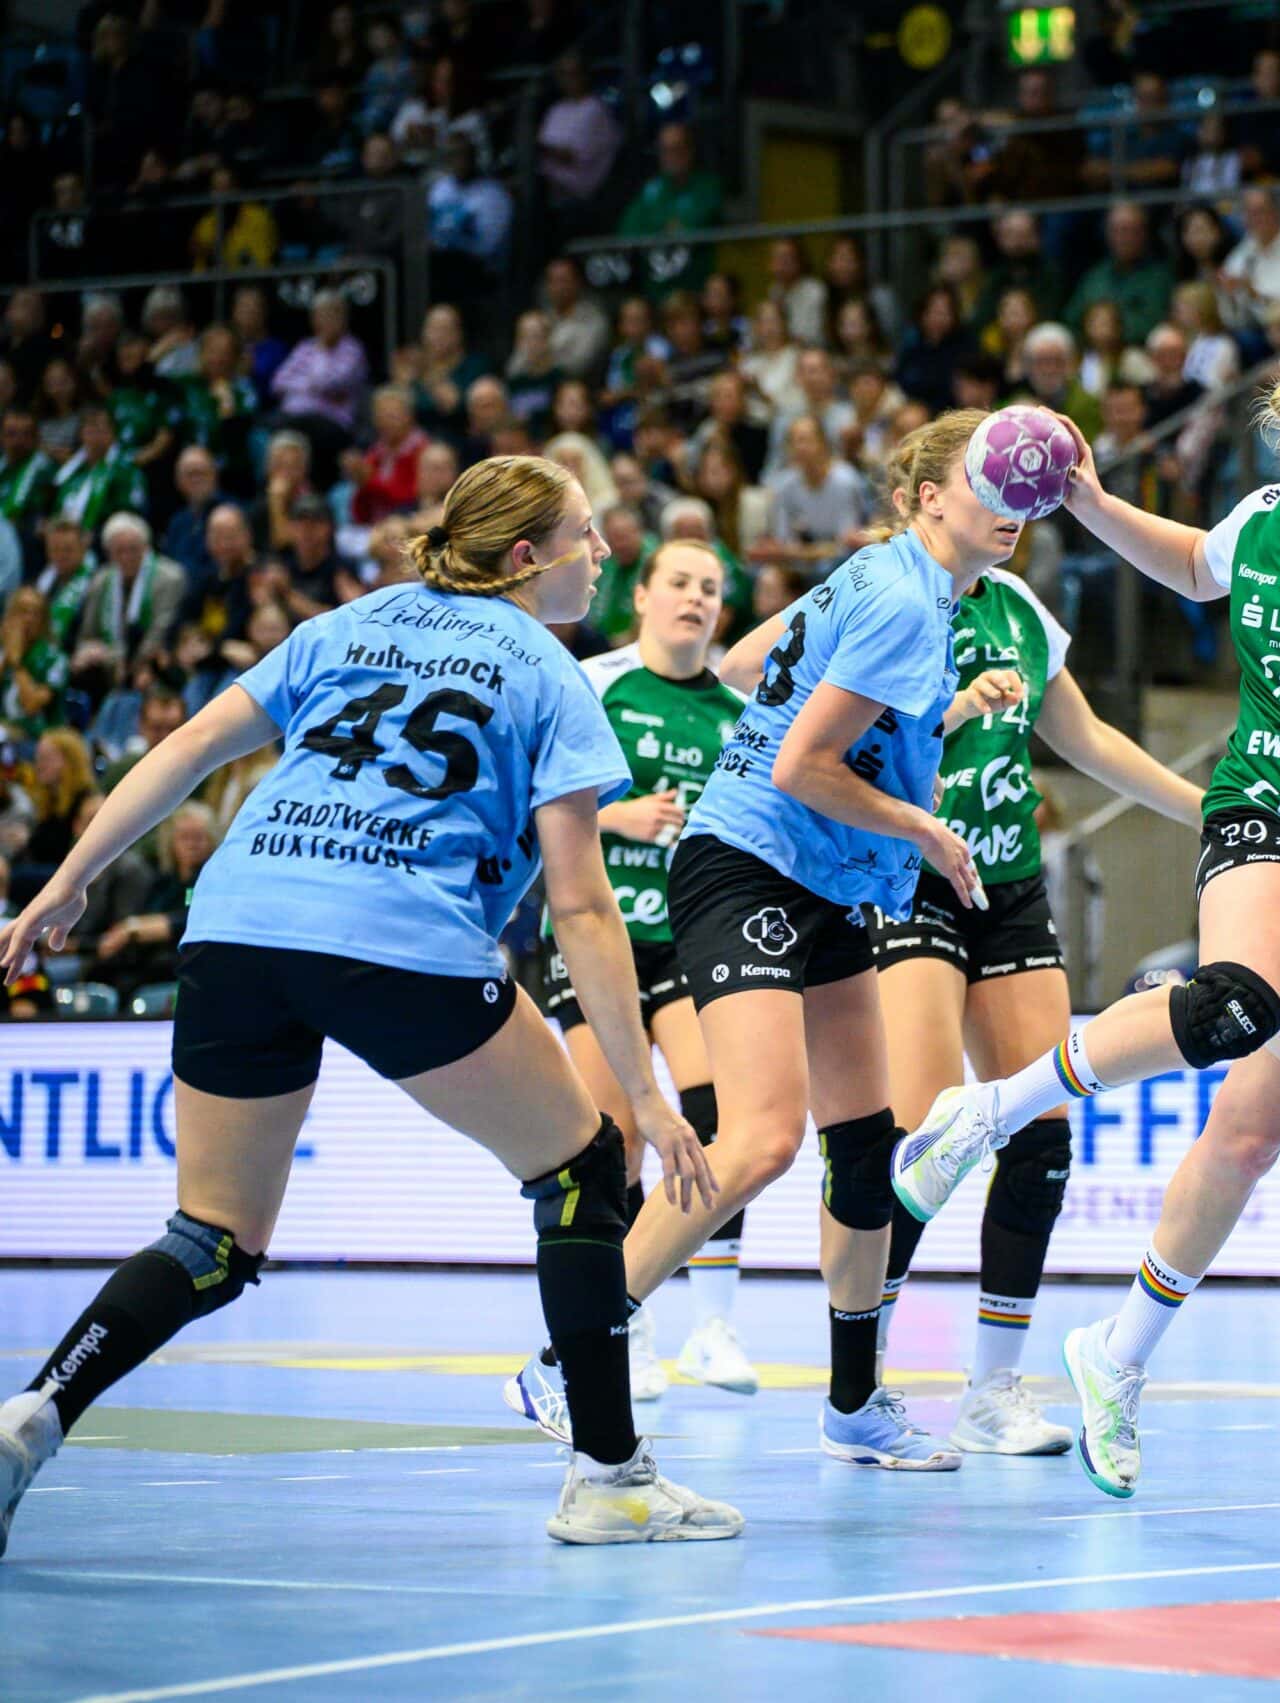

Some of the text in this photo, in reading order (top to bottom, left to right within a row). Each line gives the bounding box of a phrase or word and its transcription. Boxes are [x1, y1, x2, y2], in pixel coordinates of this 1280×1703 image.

[1239, 563, 1277, 586] Kempa
[296, 682, 494, 800] 45
[267, 800, 435, 850] STADTWERKE
[741, 964, 790, 979] Kempa
[45, 1322, 108, 1391] Kempa
